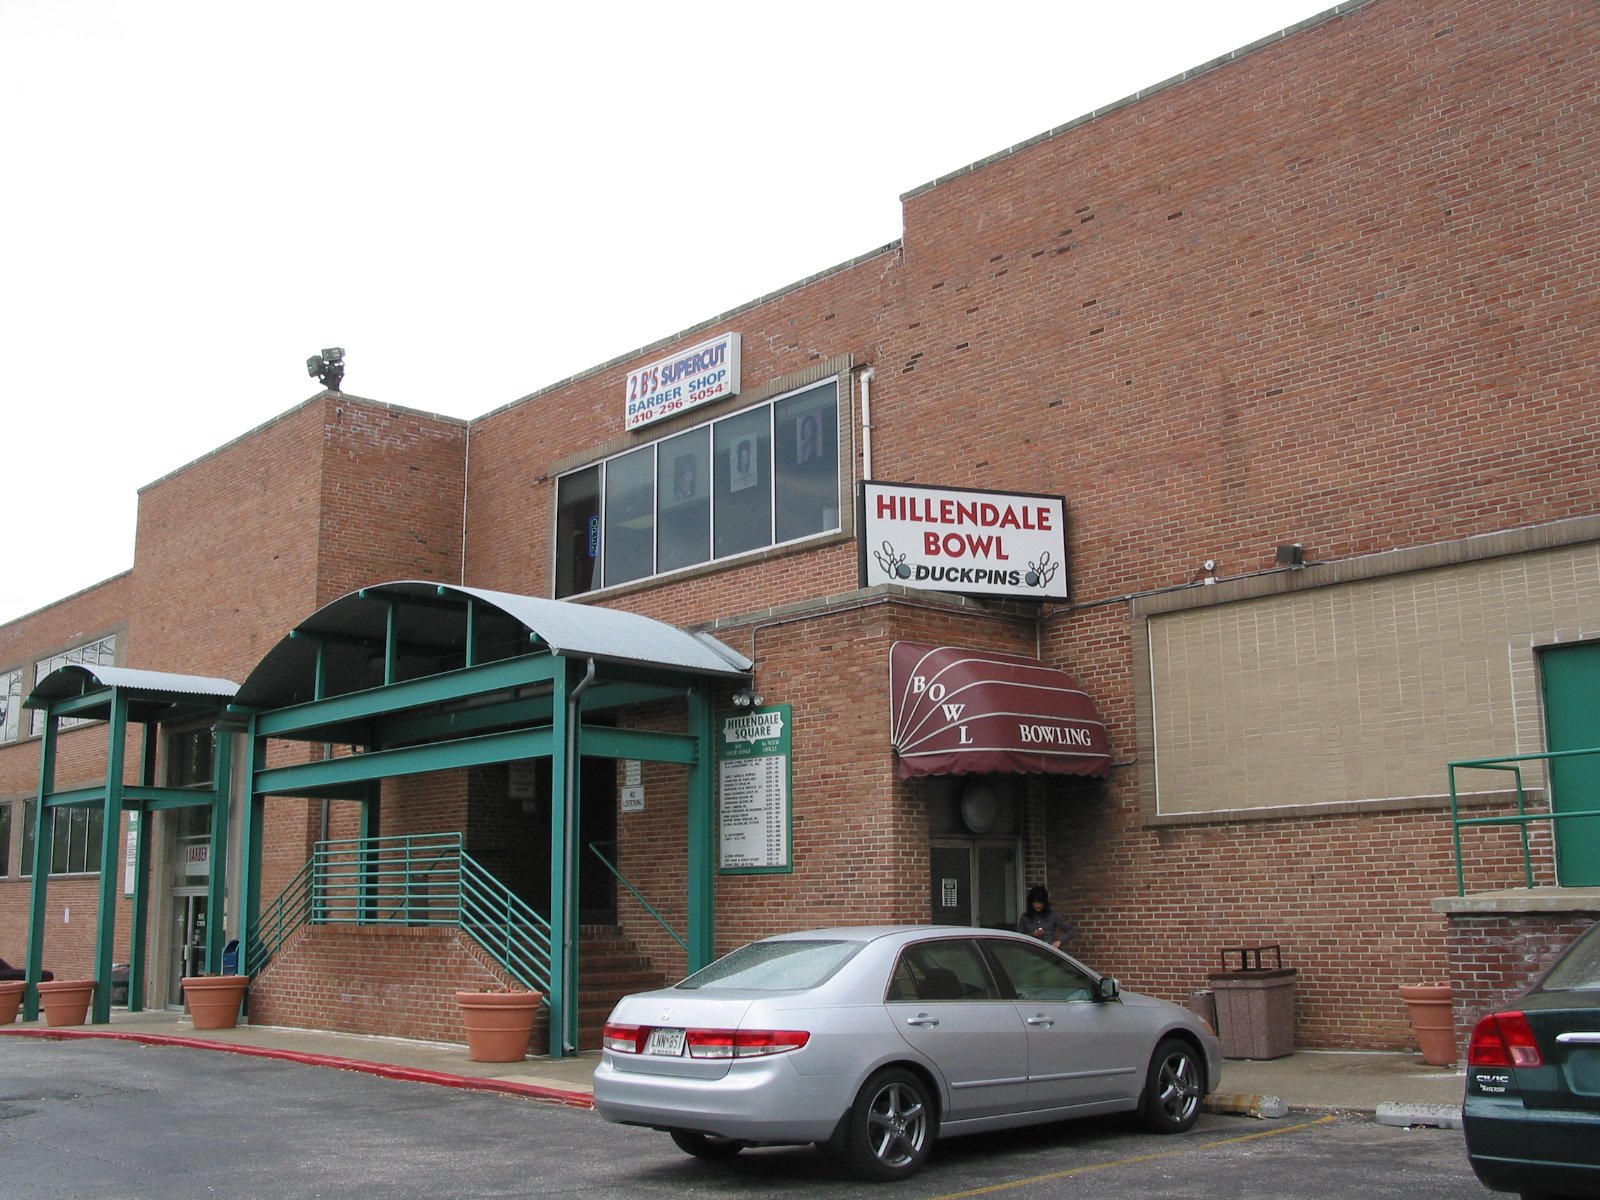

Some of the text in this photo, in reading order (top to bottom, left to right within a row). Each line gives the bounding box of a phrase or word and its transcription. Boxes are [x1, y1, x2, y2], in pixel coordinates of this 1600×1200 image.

[629, 342, 727, 402] 2 B'S SUPERCUT
[628, 369, 726, 415] BARBER SHOP
[632, 384, 724, 424] 410-296-5054
[876, 495, 1052, 531] HILLENDALE
[924, 531, 1010, 560] BOWL
[915, 565, 1020, 586] DUCKPINS
[728, 713, 779, 730] HILLENDALE
[735, 726, 771, 740] SQUARE
[1019, 724, 1092, 746] BOWLING
[1476, 1074, 1509, 1083] CIVIC
